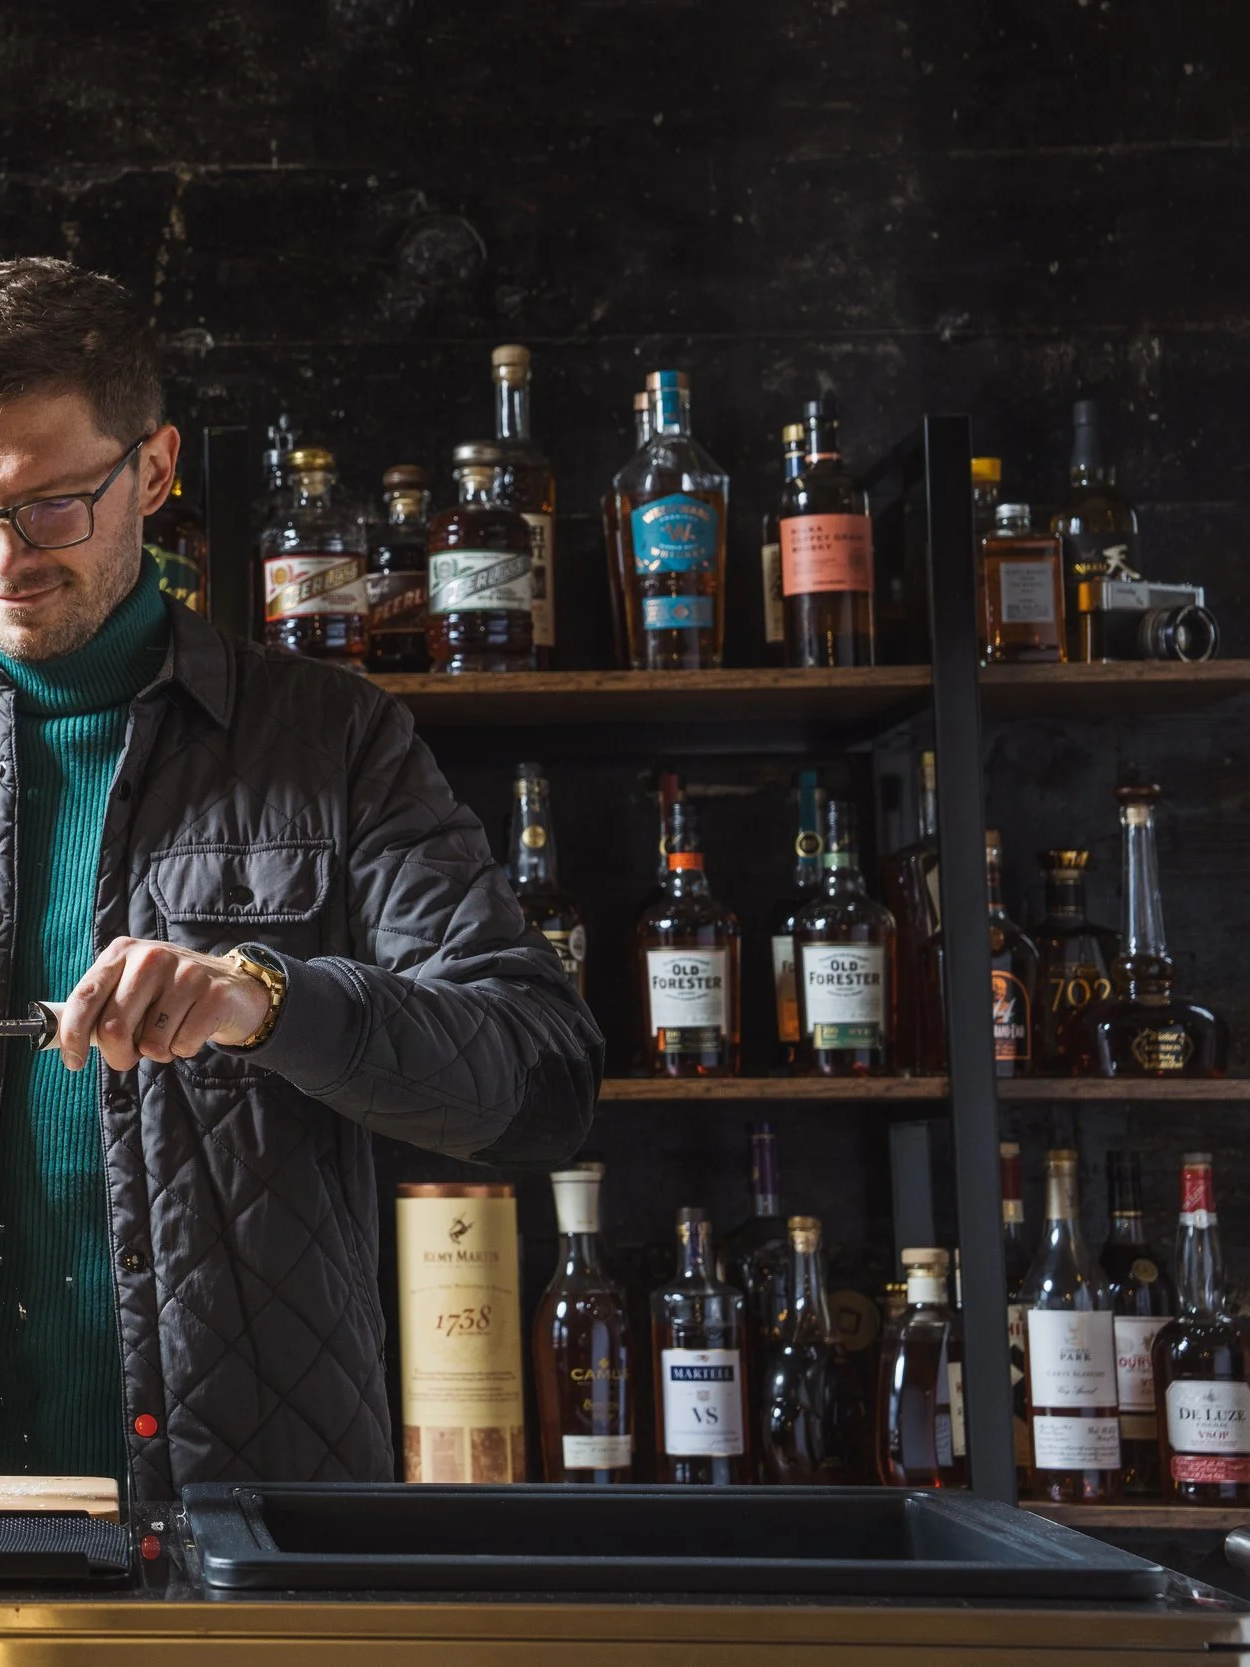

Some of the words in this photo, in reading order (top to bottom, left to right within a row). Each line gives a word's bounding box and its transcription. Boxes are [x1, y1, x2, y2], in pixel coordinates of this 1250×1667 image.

[374, 587, 423, 625] PEERL
[672, 964, 700, 976] OLD
[830, 960, 858, 972] OLD
[652, 976, 723, 990] FORESTER
[809, 972, 881, 986] FORESTER
[435, 1305, 492, 1337] 1738
[1059, 1351, 1092, 1361] PARK
[672, 1367, 733, 1380] MARTELL
[691, 1406, 719, 1425] VS
[1179, 1407, 1201, 1420] DE
[1206, 1408, 1246, 1421] LUZE
